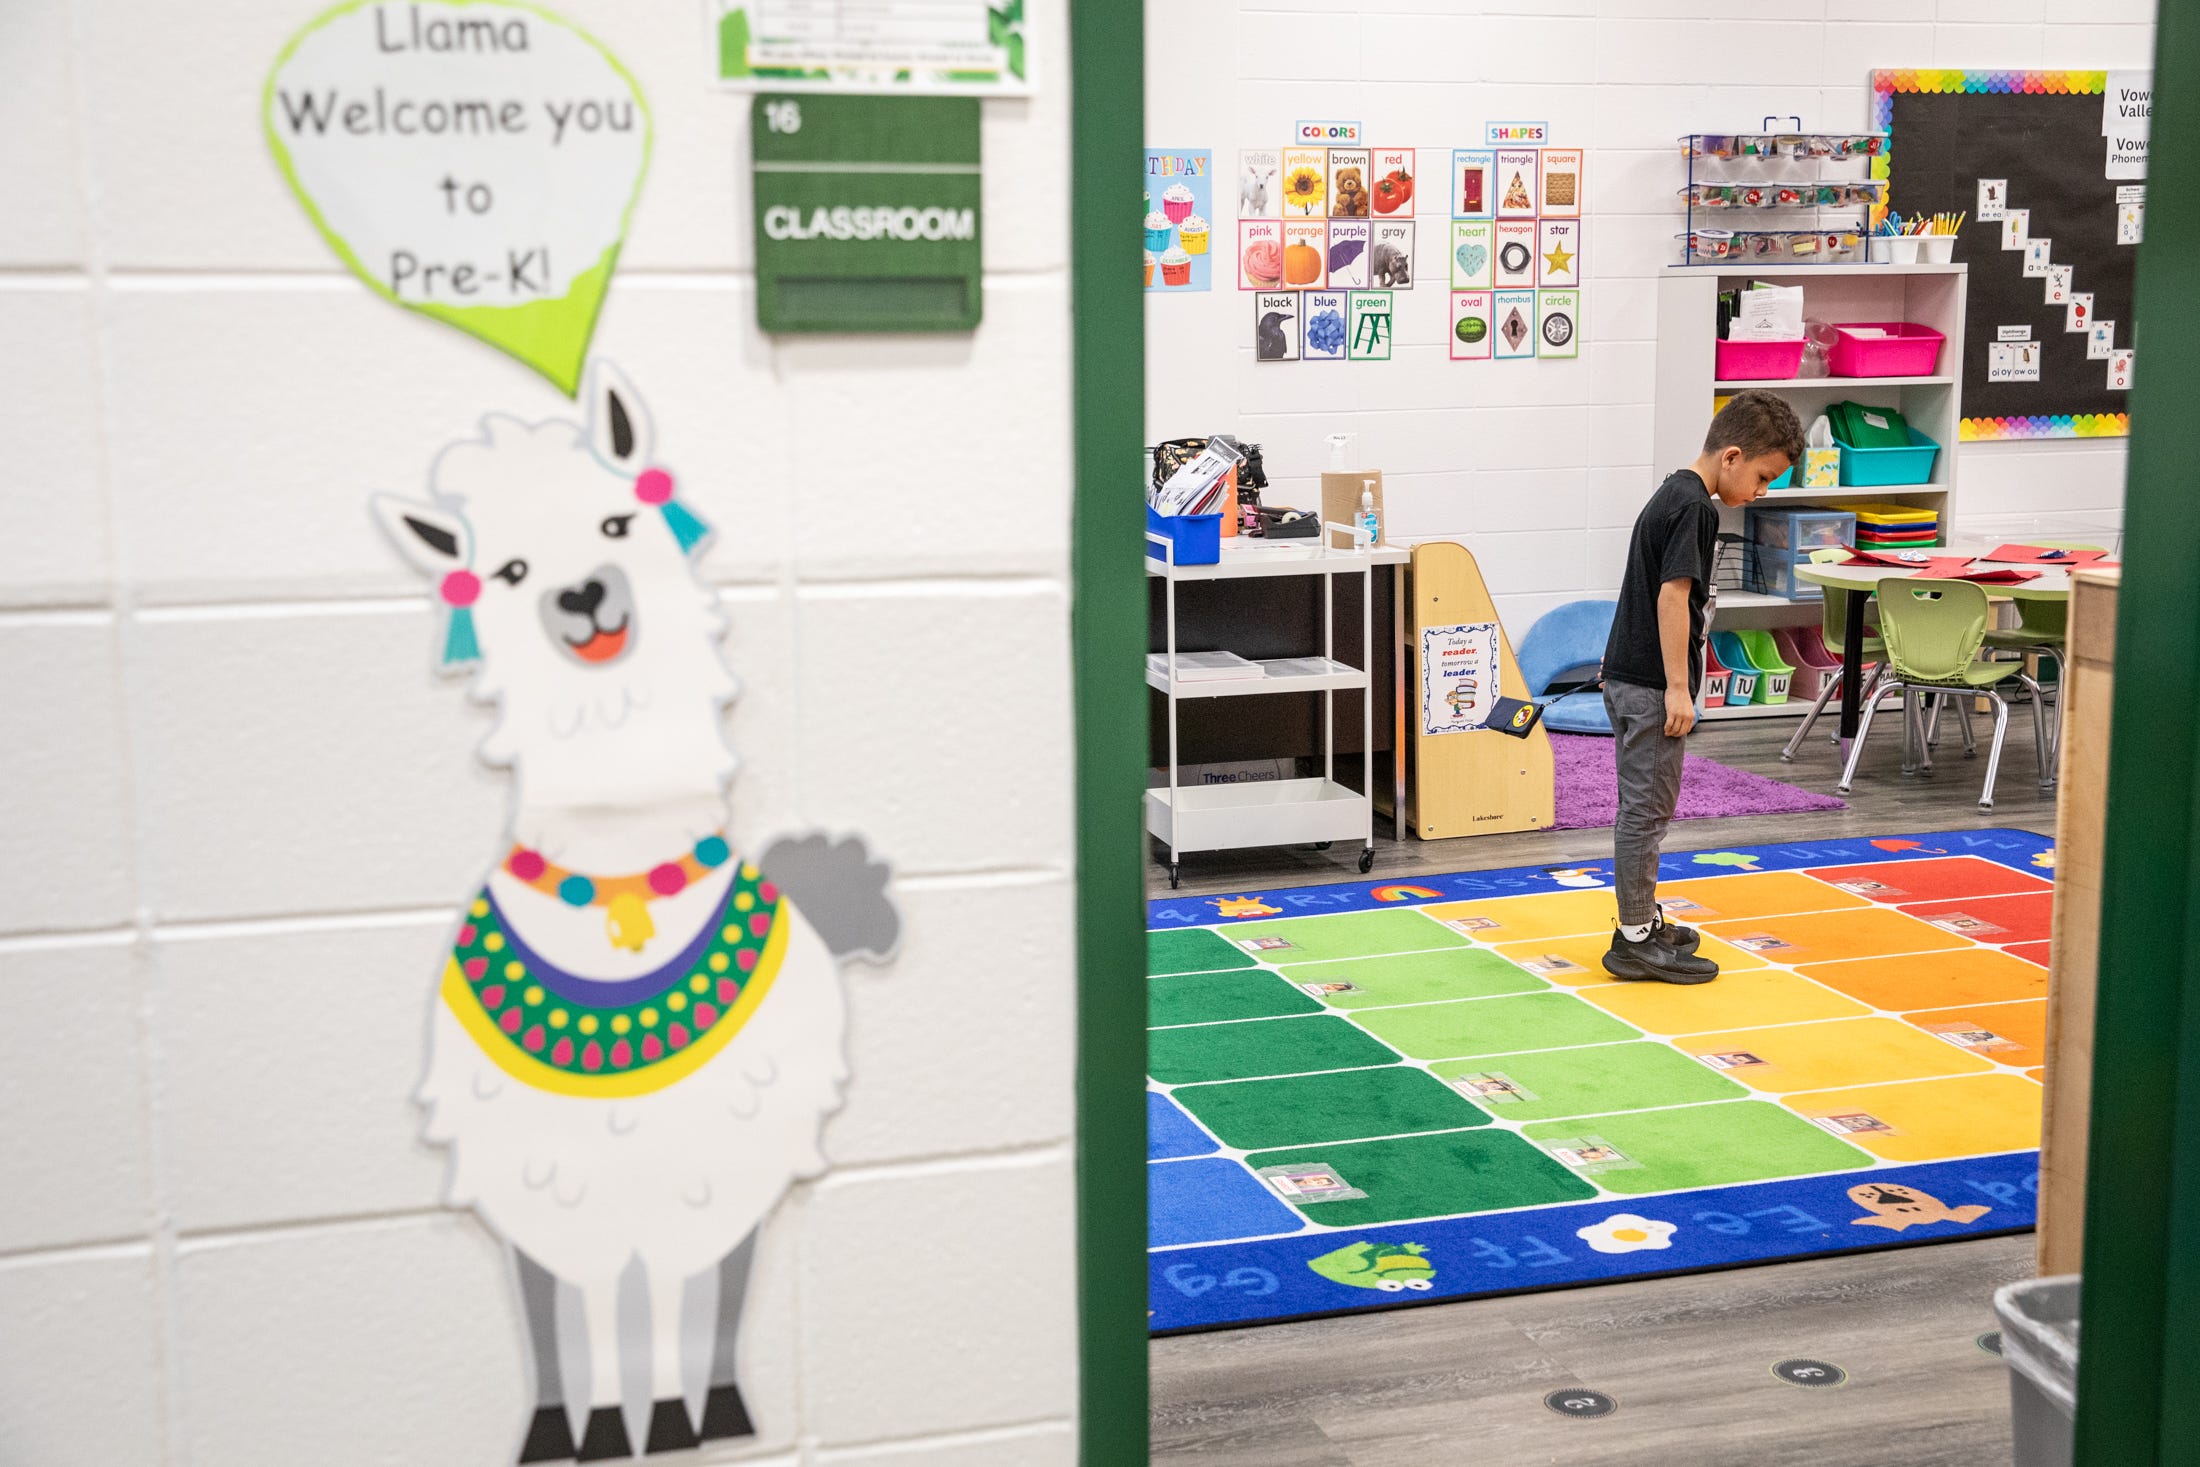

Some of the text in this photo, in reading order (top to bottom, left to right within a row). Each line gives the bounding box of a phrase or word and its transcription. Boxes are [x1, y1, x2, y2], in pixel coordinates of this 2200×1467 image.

[376, 6, 528, 53] Llama
[2120, 89, 2153, 101] Vow
[280, 90, 633, 144] Welcome you
[764, 102, 801, 133] 16
[1303, 127, 1356, 138] COLORS
[1491, 128, 1543, 139] SHAPES
[1245, 153, 1276, 165] white
[1288, 154, 1322, 165] yellow
[1332, 154, 1366, 164] brown
[1385, 154, 1403, 164] red
[1457, 155, 1491, 164] rectangle
[1501, 155, 1533, 165] triangle
[1547, 155, 1576, 164] square
[1144, 156, 1207, 176] THDAY
[438, 174, 493, 215] to
[764, 208, 975, 242] CLASSROOM
[1499, 225, 1533, 234] hexagon
[1550, 225, 1570, 234] star
[1249, 225, 1272, 238] pink
[1287, 227, 1323, 238] orange
[1333, 226, 1367, 238] purple
[1382, 228, 1406, 239] gray
[1459, 227, 1486, 236] heart
[390, 250, 551, 295] Pre-K!
[1498, 296, 1531, 304] rhombus
[1545, 296, 1571, 306] circle
[2054, 291, 2061, 300] e
[1263, 297, 1292, 308] black
[1314, 296, 1337, 307] blue
[1356, 298, 1386, 309] green
[1461, 297, 1483, 307] oval
[2075, 319, 2083, 328] a
[1992, 368, 1999, 376] oi
[2001, 369, 2011, 377] oy
[2117, 378, 2124, 386] o
[1448, 638, 1467, 646] Today
[1711, 679, 1723, 694] M
[1738, 679, 1752, 694] TU
[1773, 679, 1786, 692] W
[1203, 770, 1275, 783] Three Cheers
